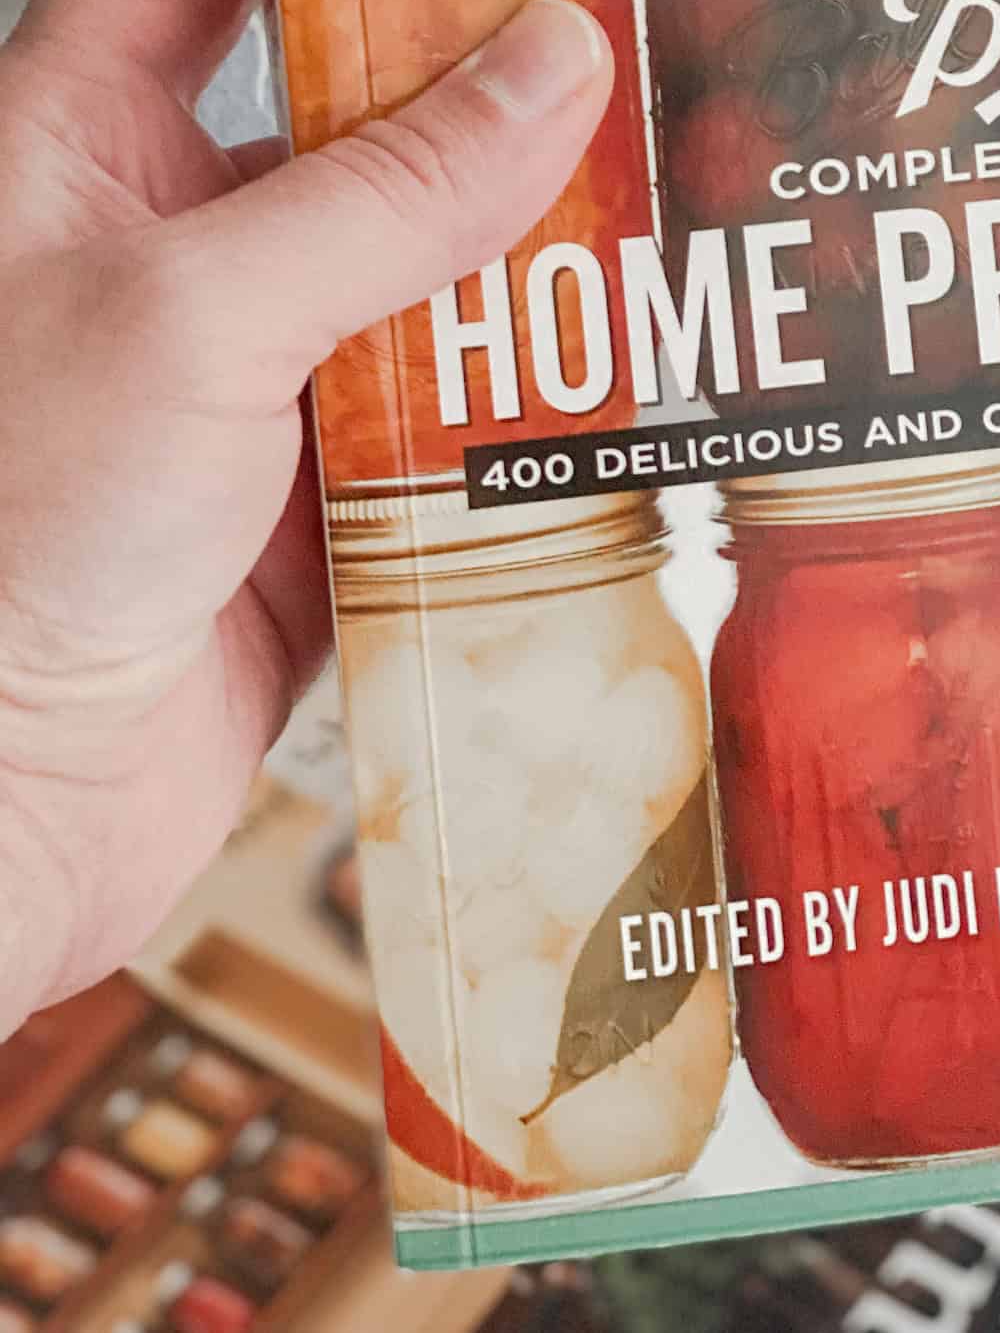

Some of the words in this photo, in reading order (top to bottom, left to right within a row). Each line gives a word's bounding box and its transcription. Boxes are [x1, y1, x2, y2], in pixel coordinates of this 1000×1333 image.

[428, 220, 826, 426] HOME
[480, 452, 575, 492] 400
[596, 422, 844, 479] DELICIOUS
[863, 408, 962, 449] AND
[619, 897, 785, 982] EDITED
[802, 886, 860, 957] BY
[882, 871, 979, 947] JUDI
